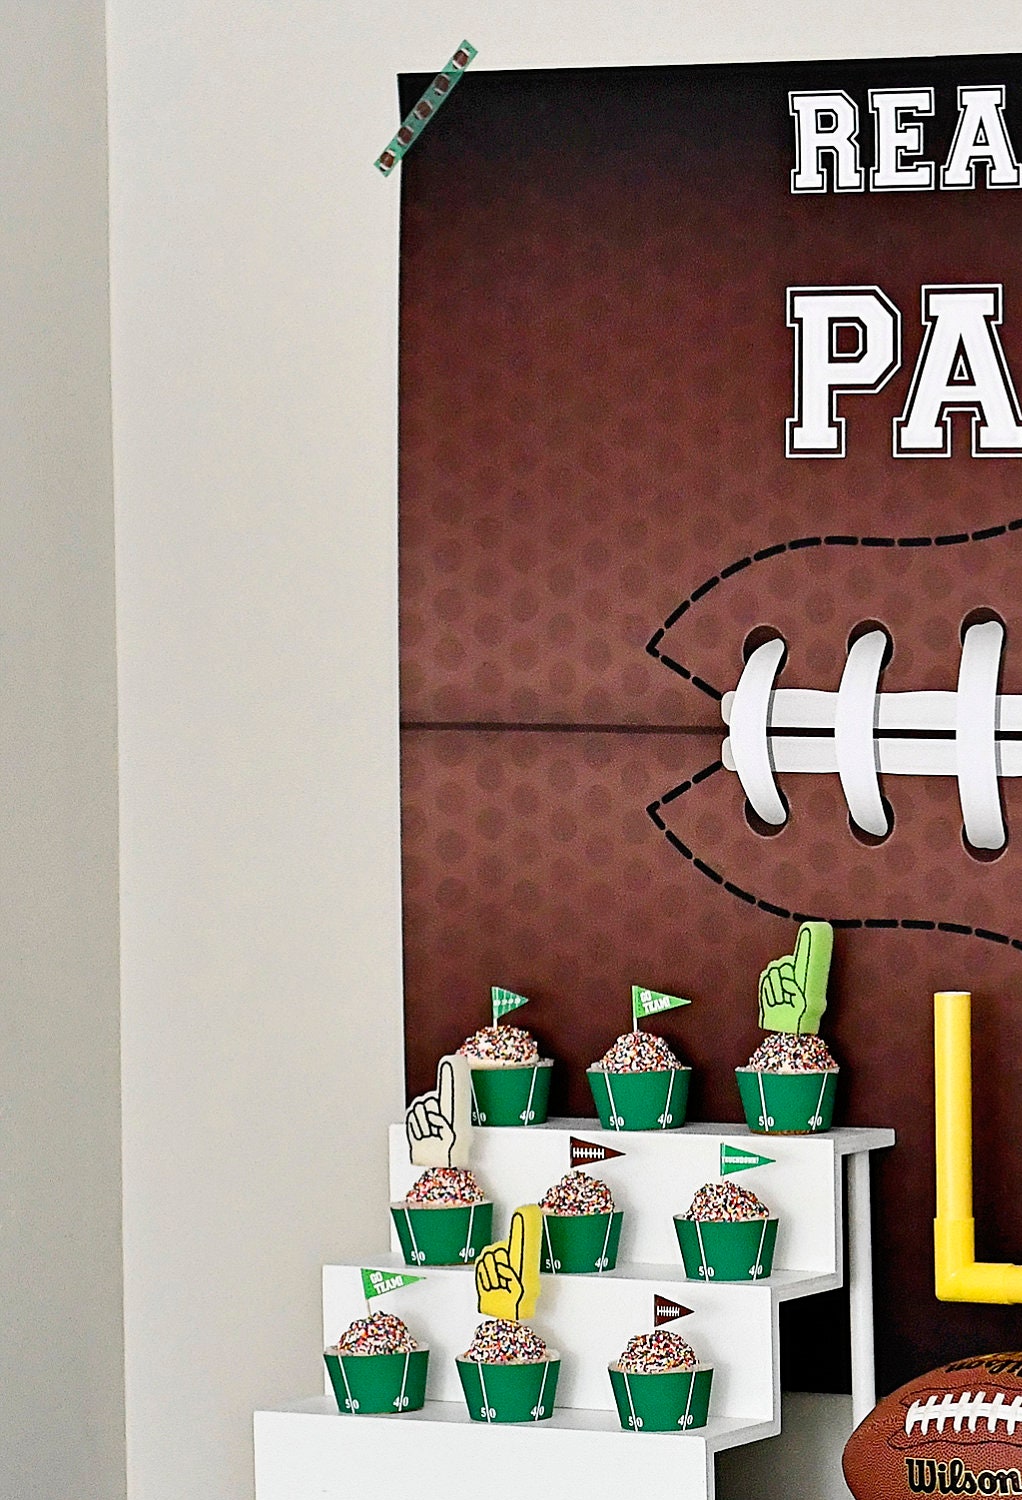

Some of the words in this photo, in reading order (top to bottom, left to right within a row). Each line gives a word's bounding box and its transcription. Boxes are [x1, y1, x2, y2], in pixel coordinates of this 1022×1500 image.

[640, 990, 652, 1002] GO
[472, 1112, 486, 1122] 50
[520, 1111, 535, 1120] 40
[610, 1116, 624, 1126] 50
[658, 1114, 672, 1124] 40
[759, 1116, 774, 1126] 50
[808, 1116, 822, 1126] 40
[411, 1251, 425, 1261] 50
[459, 1248, 475, 1258] 40
[546, 1259, 561, 1269] 50
[595, 1258, 608, 1268] 40
[699, 1266, 714, 1276] 50
[749, 1265, 762, 1275] 40
[370, 1272, 383, 1284] GO
[345, 1399, 359, 1409] 50
[393, 1396, 409, 1407] 40
[481, 1407, 496, 1418] 50
[531, 1406, 544, 1416] 40
[628, 1416, 643, 1427] 50
[678, 1415, 693, 1425] 40
